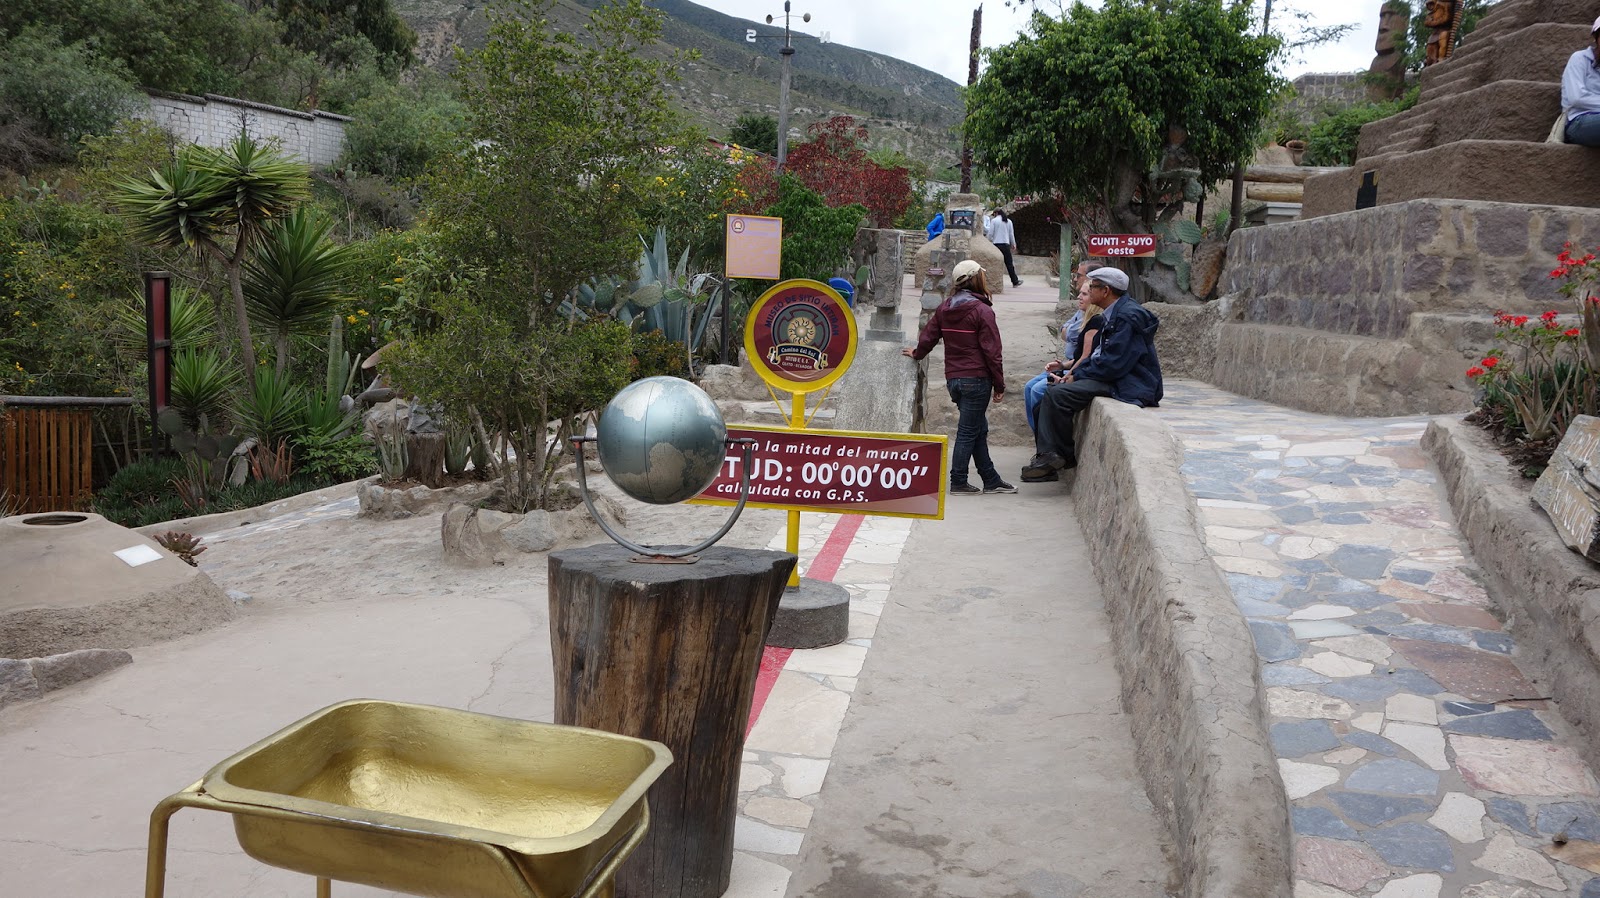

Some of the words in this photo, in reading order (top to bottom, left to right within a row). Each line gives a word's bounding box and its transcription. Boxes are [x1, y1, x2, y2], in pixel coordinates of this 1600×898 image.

[1090, 237, 1119, 246] CUNTI
[1127, 237, 1153, 246] SUYO
[1107, 247, 1135, 255] oeste
[764, 300, 784, 328] MUSEO
[785, 295, 797, 304] DE
[799, 293, 821, 305] SITIO
[765, 440, 779, 452] la
[785, 442, 830, 456] mitad
[836, 444, 861, 458] del
[866, 449, 919, 461] mundo
[717, 482, 790, 497] calulada
[795, 489, 821, 499] con
[826, 489, 869, 502] G.P.S.
